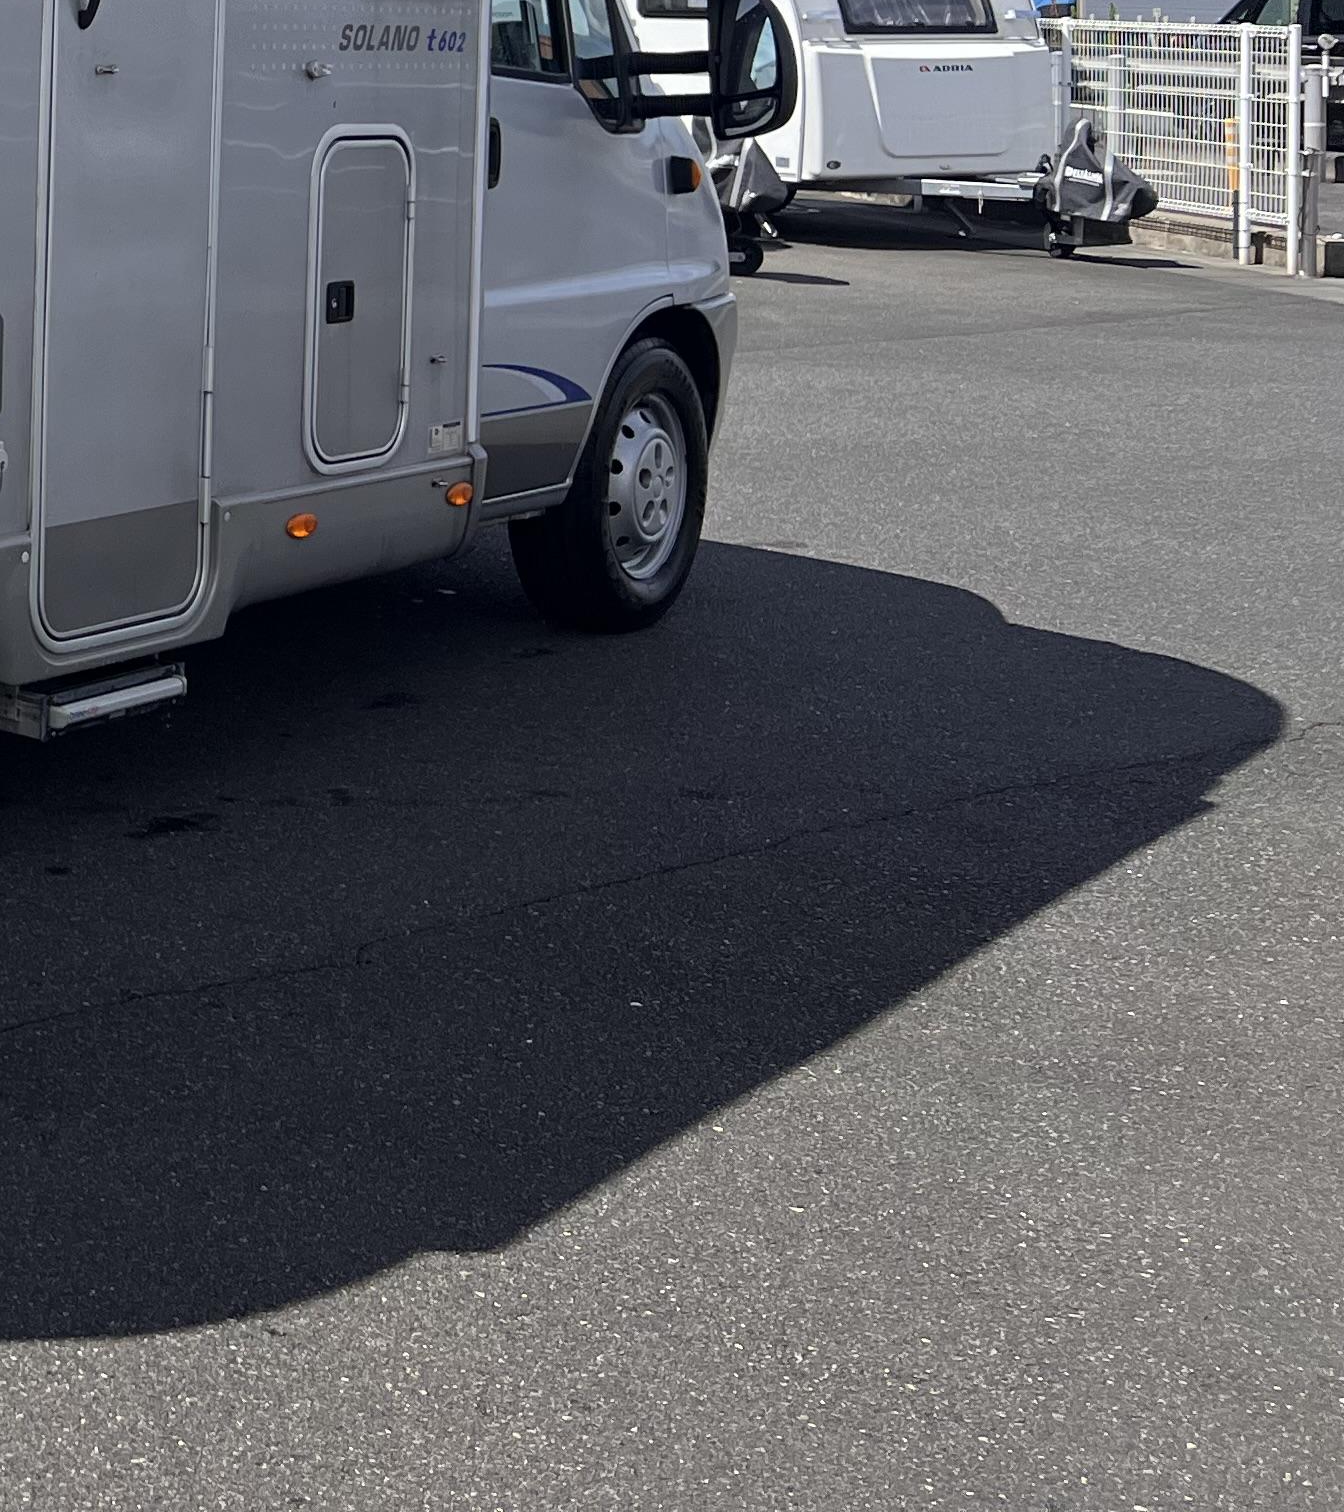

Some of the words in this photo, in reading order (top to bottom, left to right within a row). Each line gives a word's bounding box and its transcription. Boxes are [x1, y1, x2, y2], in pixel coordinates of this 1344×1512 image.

[338, 23, 421, 52] SOLANO
[426, 28, 467, 53] t602
[932, 64, 974, 73] ADRIA
